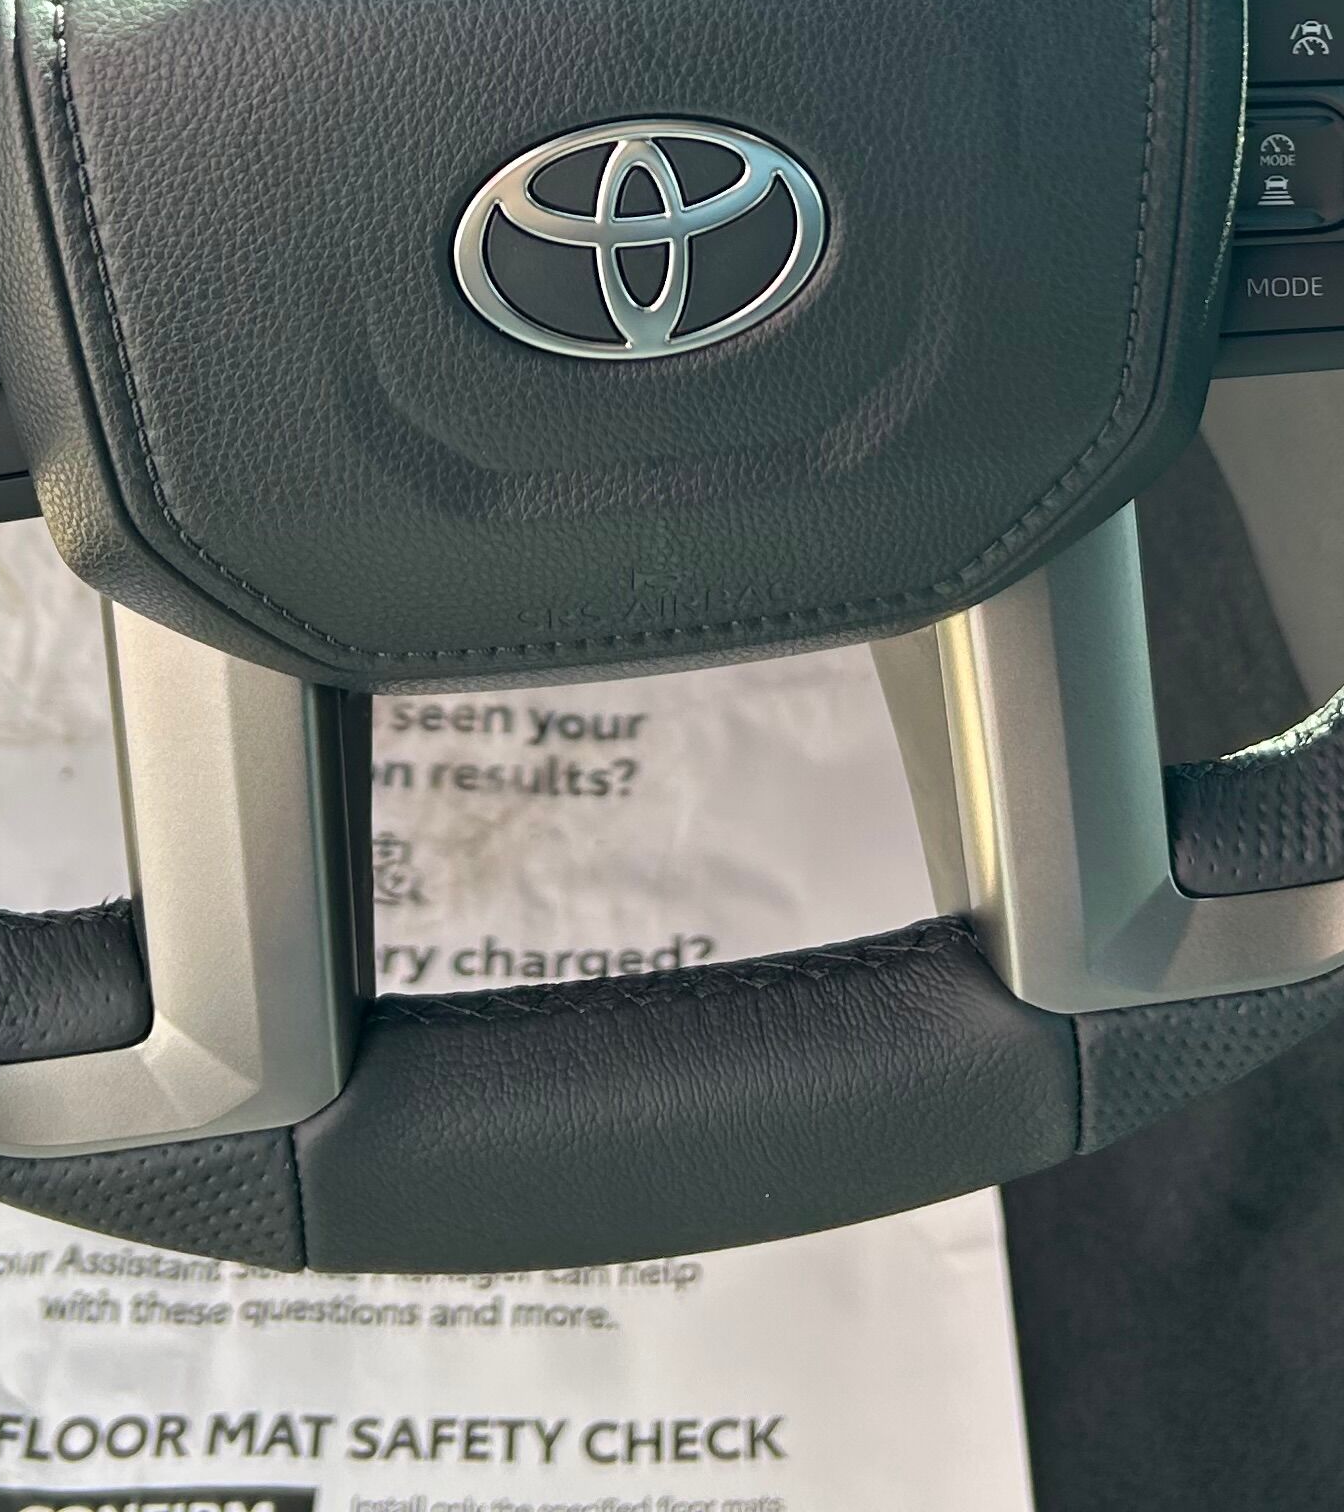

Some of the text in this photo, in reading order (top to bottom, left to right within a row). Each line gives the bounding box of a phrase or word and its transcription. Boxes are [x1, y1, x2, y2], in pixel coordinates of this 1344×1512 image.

[1259, 153, 1297, 167] MODE
[1246, 275, 1325, 298] MODE
[390, 699, 648, 747] seen your
[427, 755, 641, 798] results?
[41, 1288, 621, 1330] with these questions and more.
[205, 1412, 334, 1458] MAT
[348, 1414, 567, 1464] SAFETY
[582, 1415, 788, 1464] CHECK
